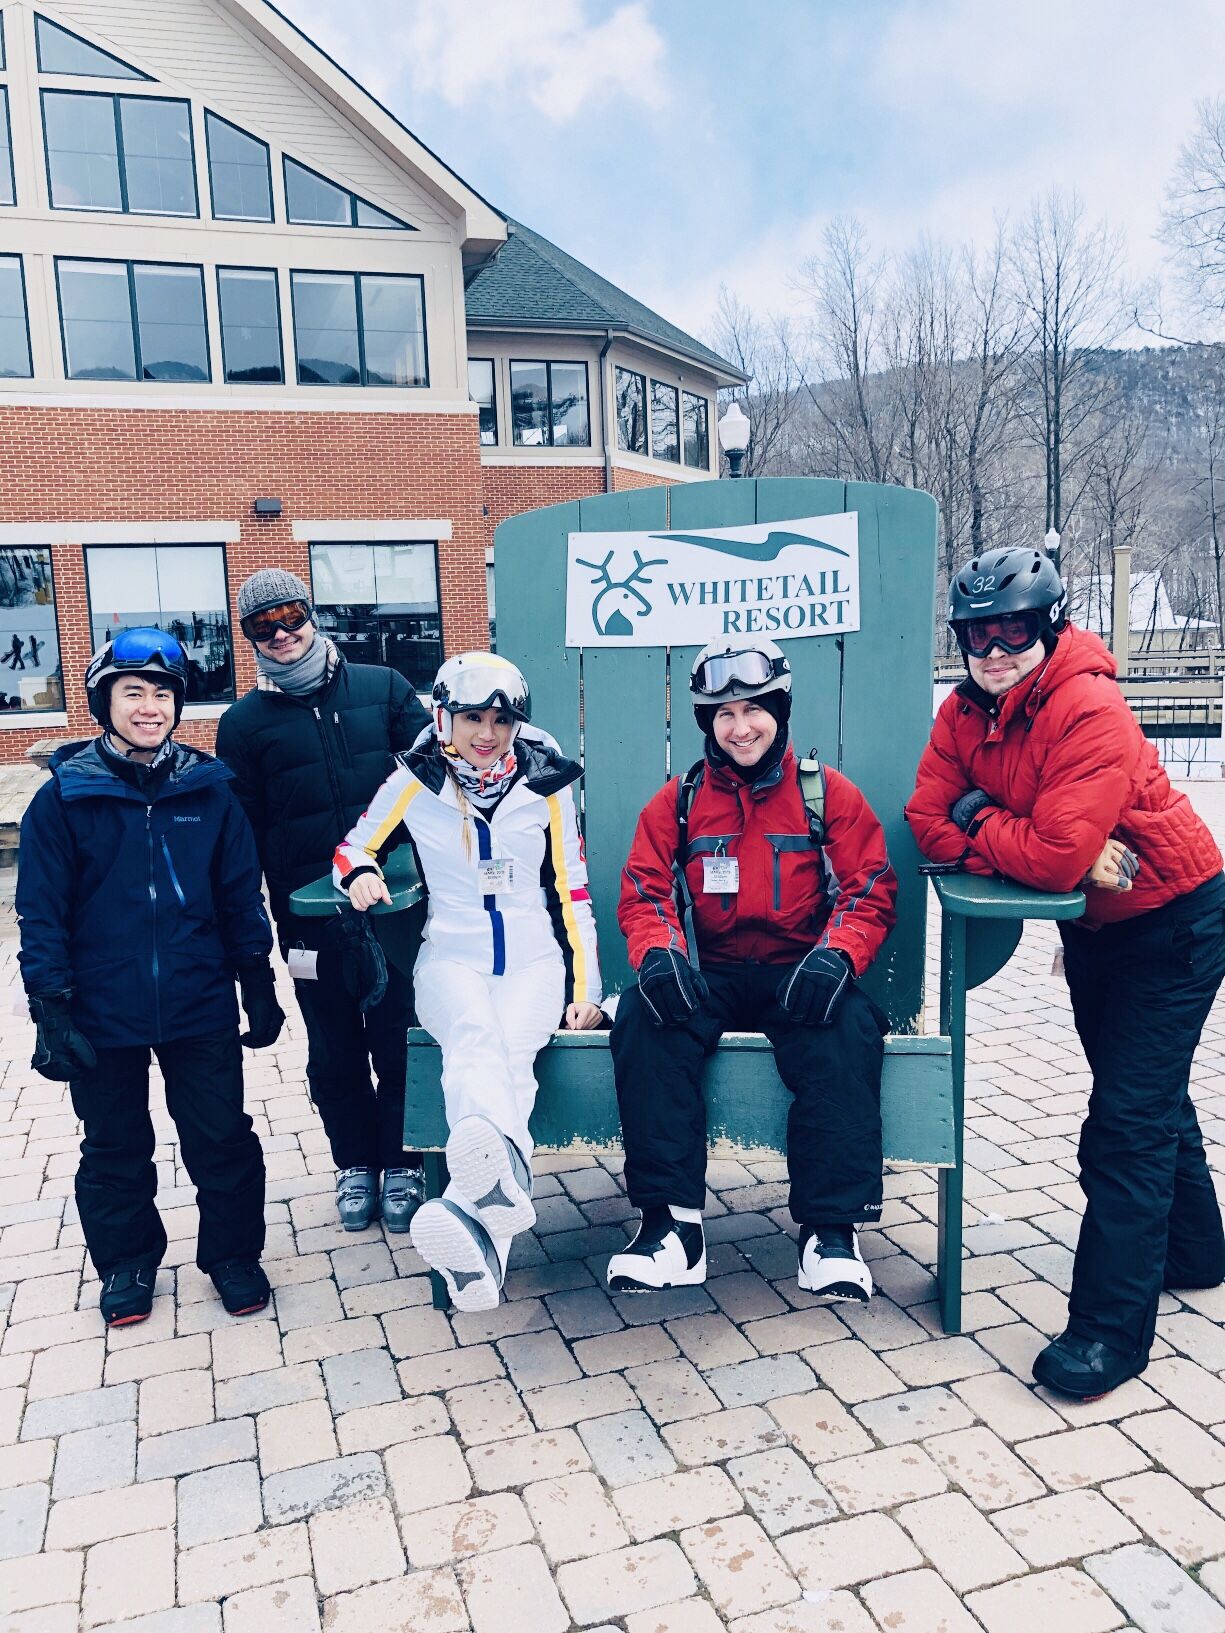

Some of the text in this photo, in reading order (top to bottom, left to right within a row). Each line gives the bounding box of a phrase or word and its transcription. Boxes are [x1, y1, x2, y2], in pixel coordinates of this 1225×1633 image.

[667, 570, 850, 606] WHITETAIL
[972, 575, 996, 593] 32
[722, 600, 850, 634] RESORT
